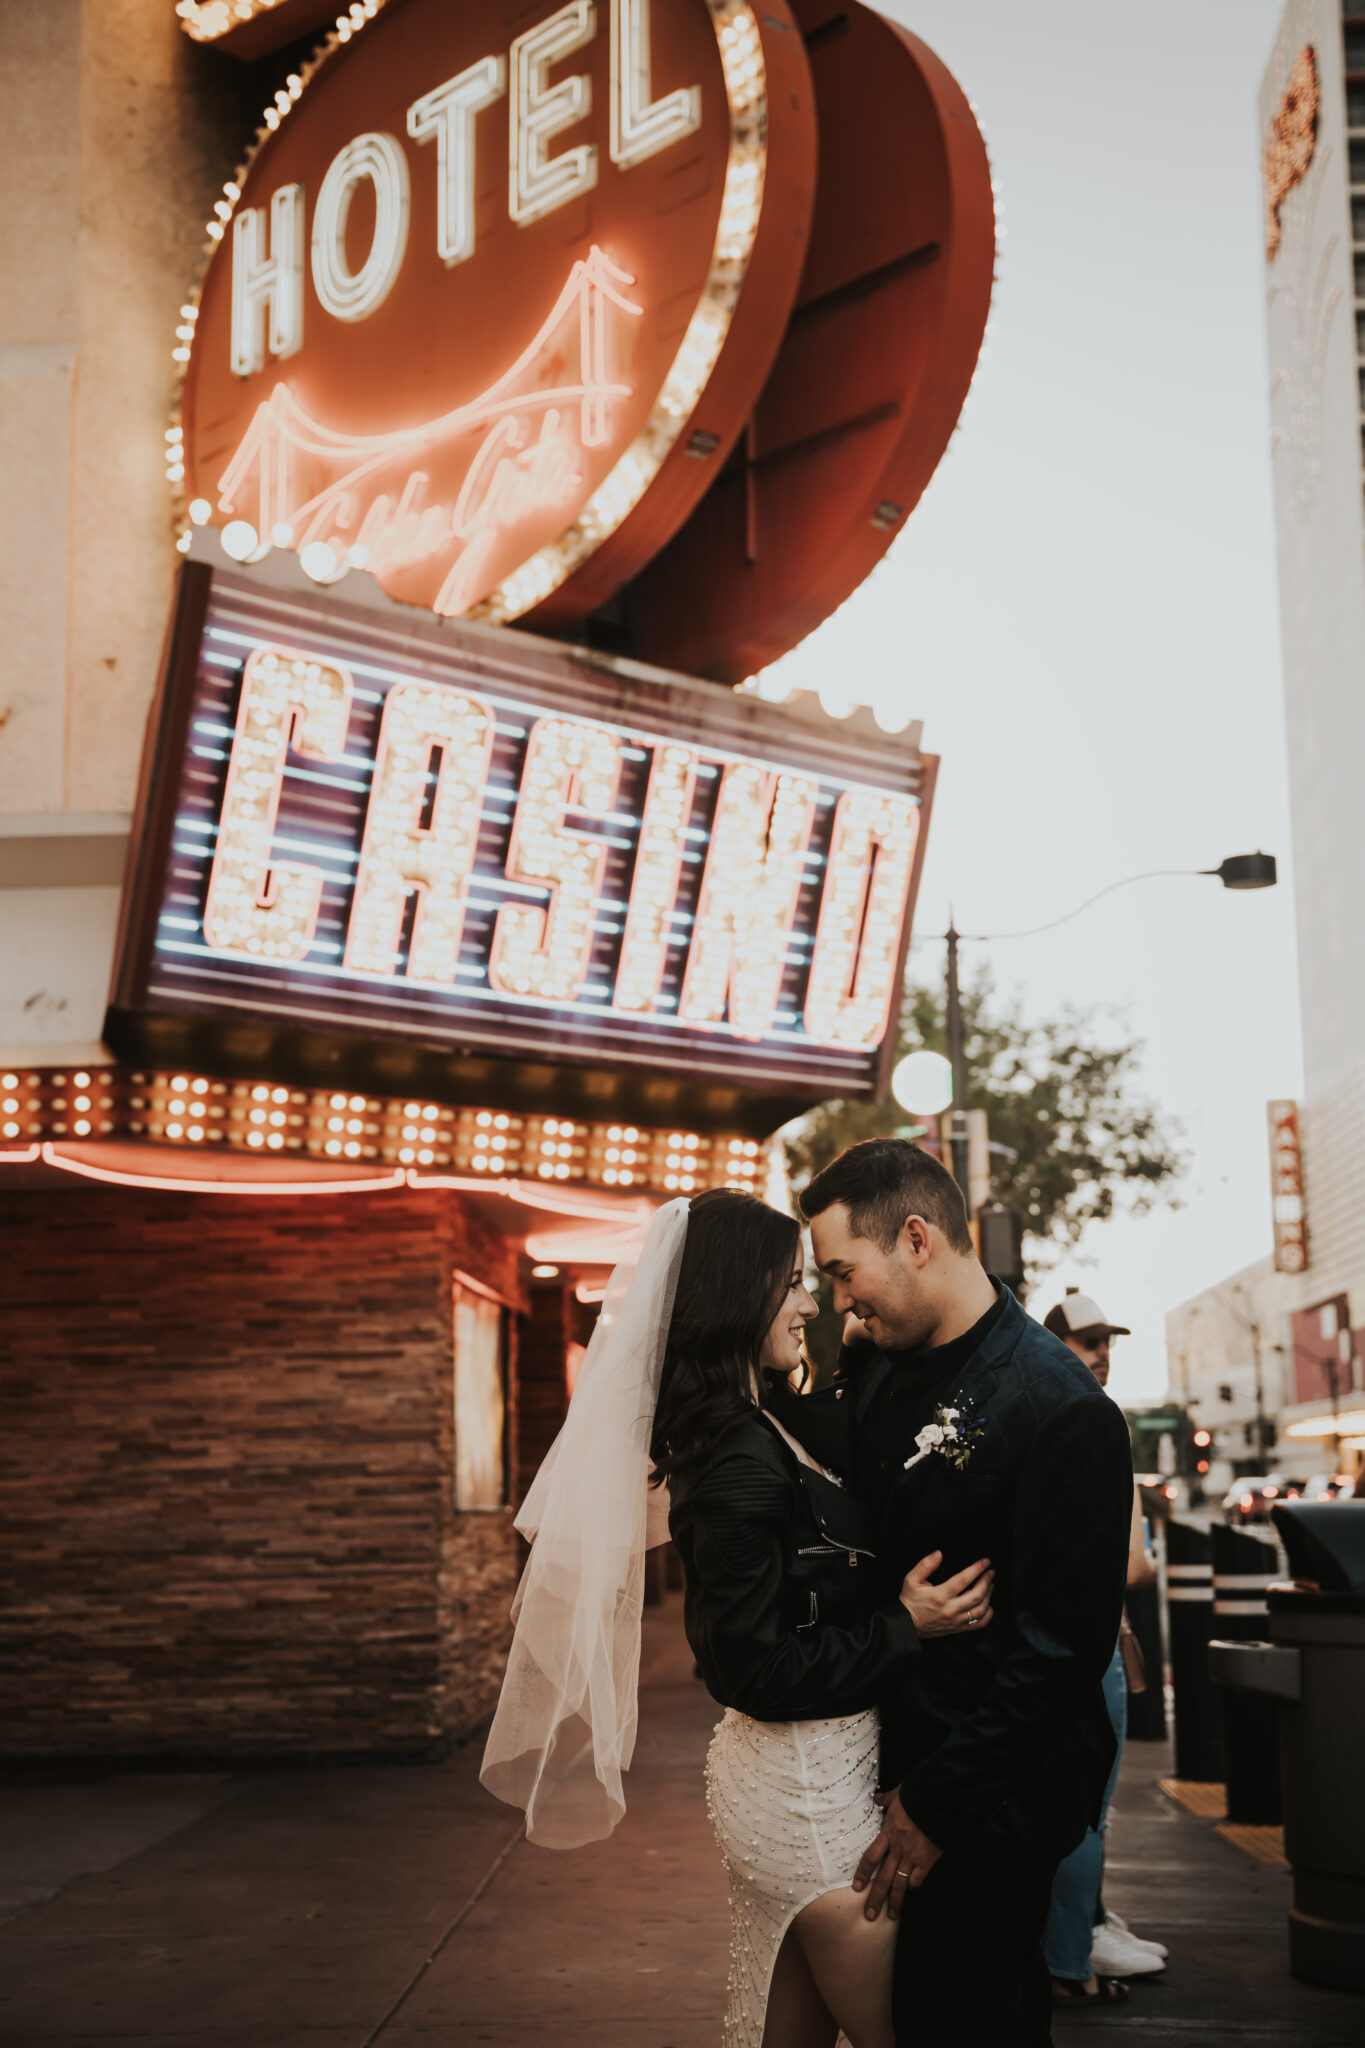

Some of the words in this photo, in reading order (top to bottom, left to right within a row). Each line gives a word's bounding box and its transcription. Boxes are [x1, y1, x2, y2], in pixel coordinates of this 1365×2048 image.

[230, 0, 704, 378] HOTEL
[202, 645, 921, 1053] CASINO
[1274, 1104, 1304, 1272] PARKNG
